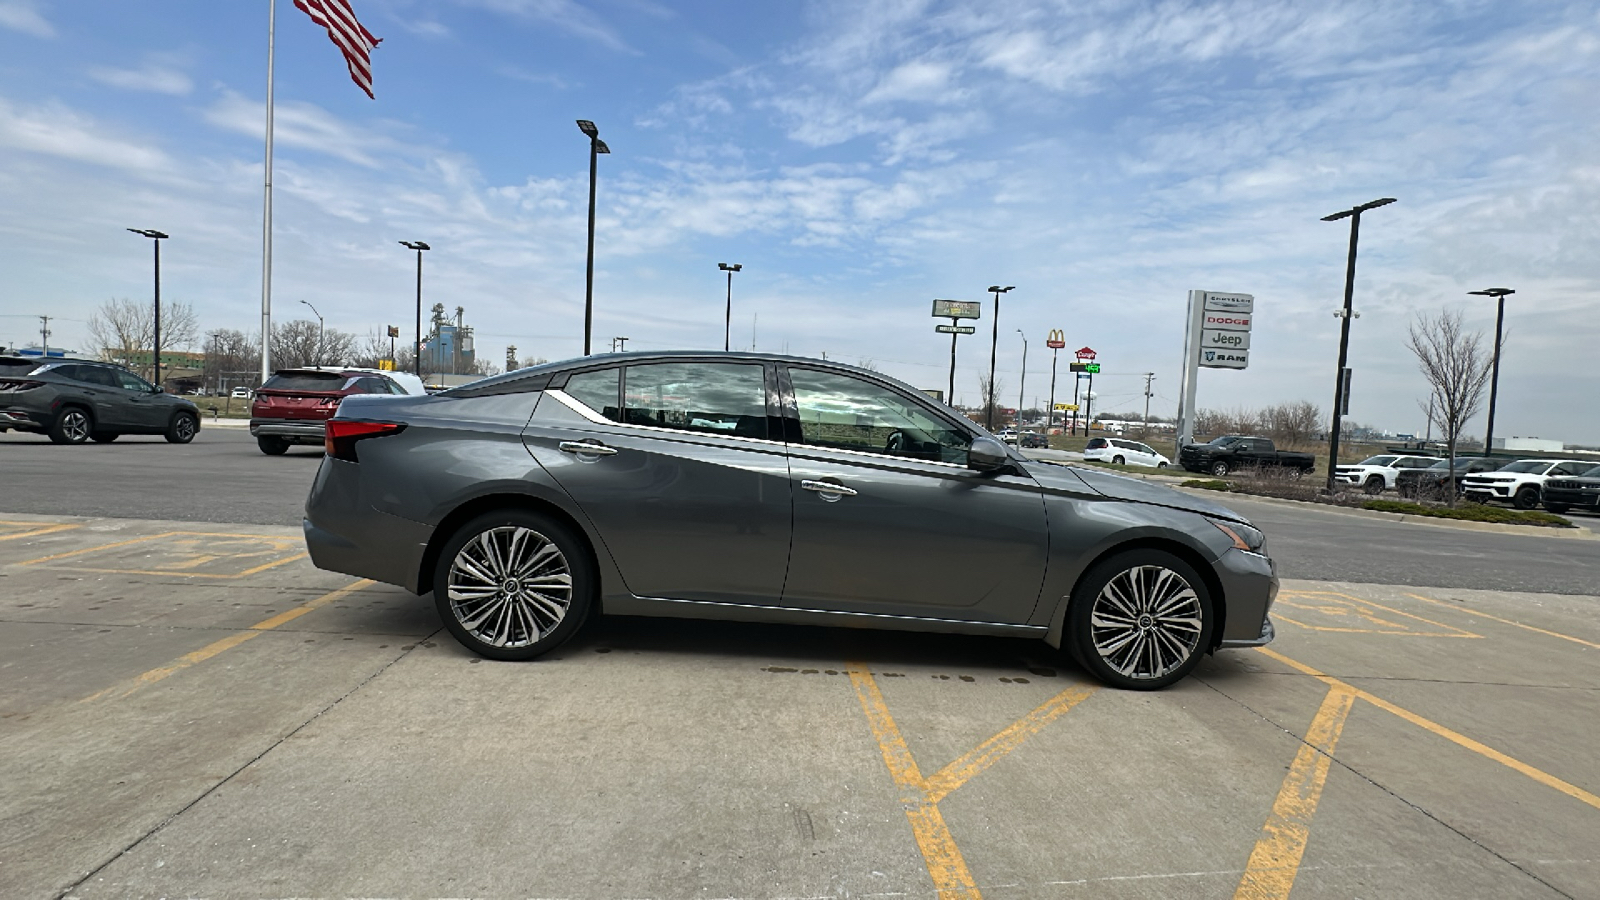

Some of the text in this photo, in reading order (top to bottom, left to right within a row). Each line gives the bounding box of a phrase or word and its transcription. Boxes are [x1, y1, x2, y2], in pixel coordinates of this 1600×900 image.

[1207, 316, 1249, 325] DODGE
[1212, 333, 1242, 346] Jeep
[1217, 354, 1246, 362] RAM
